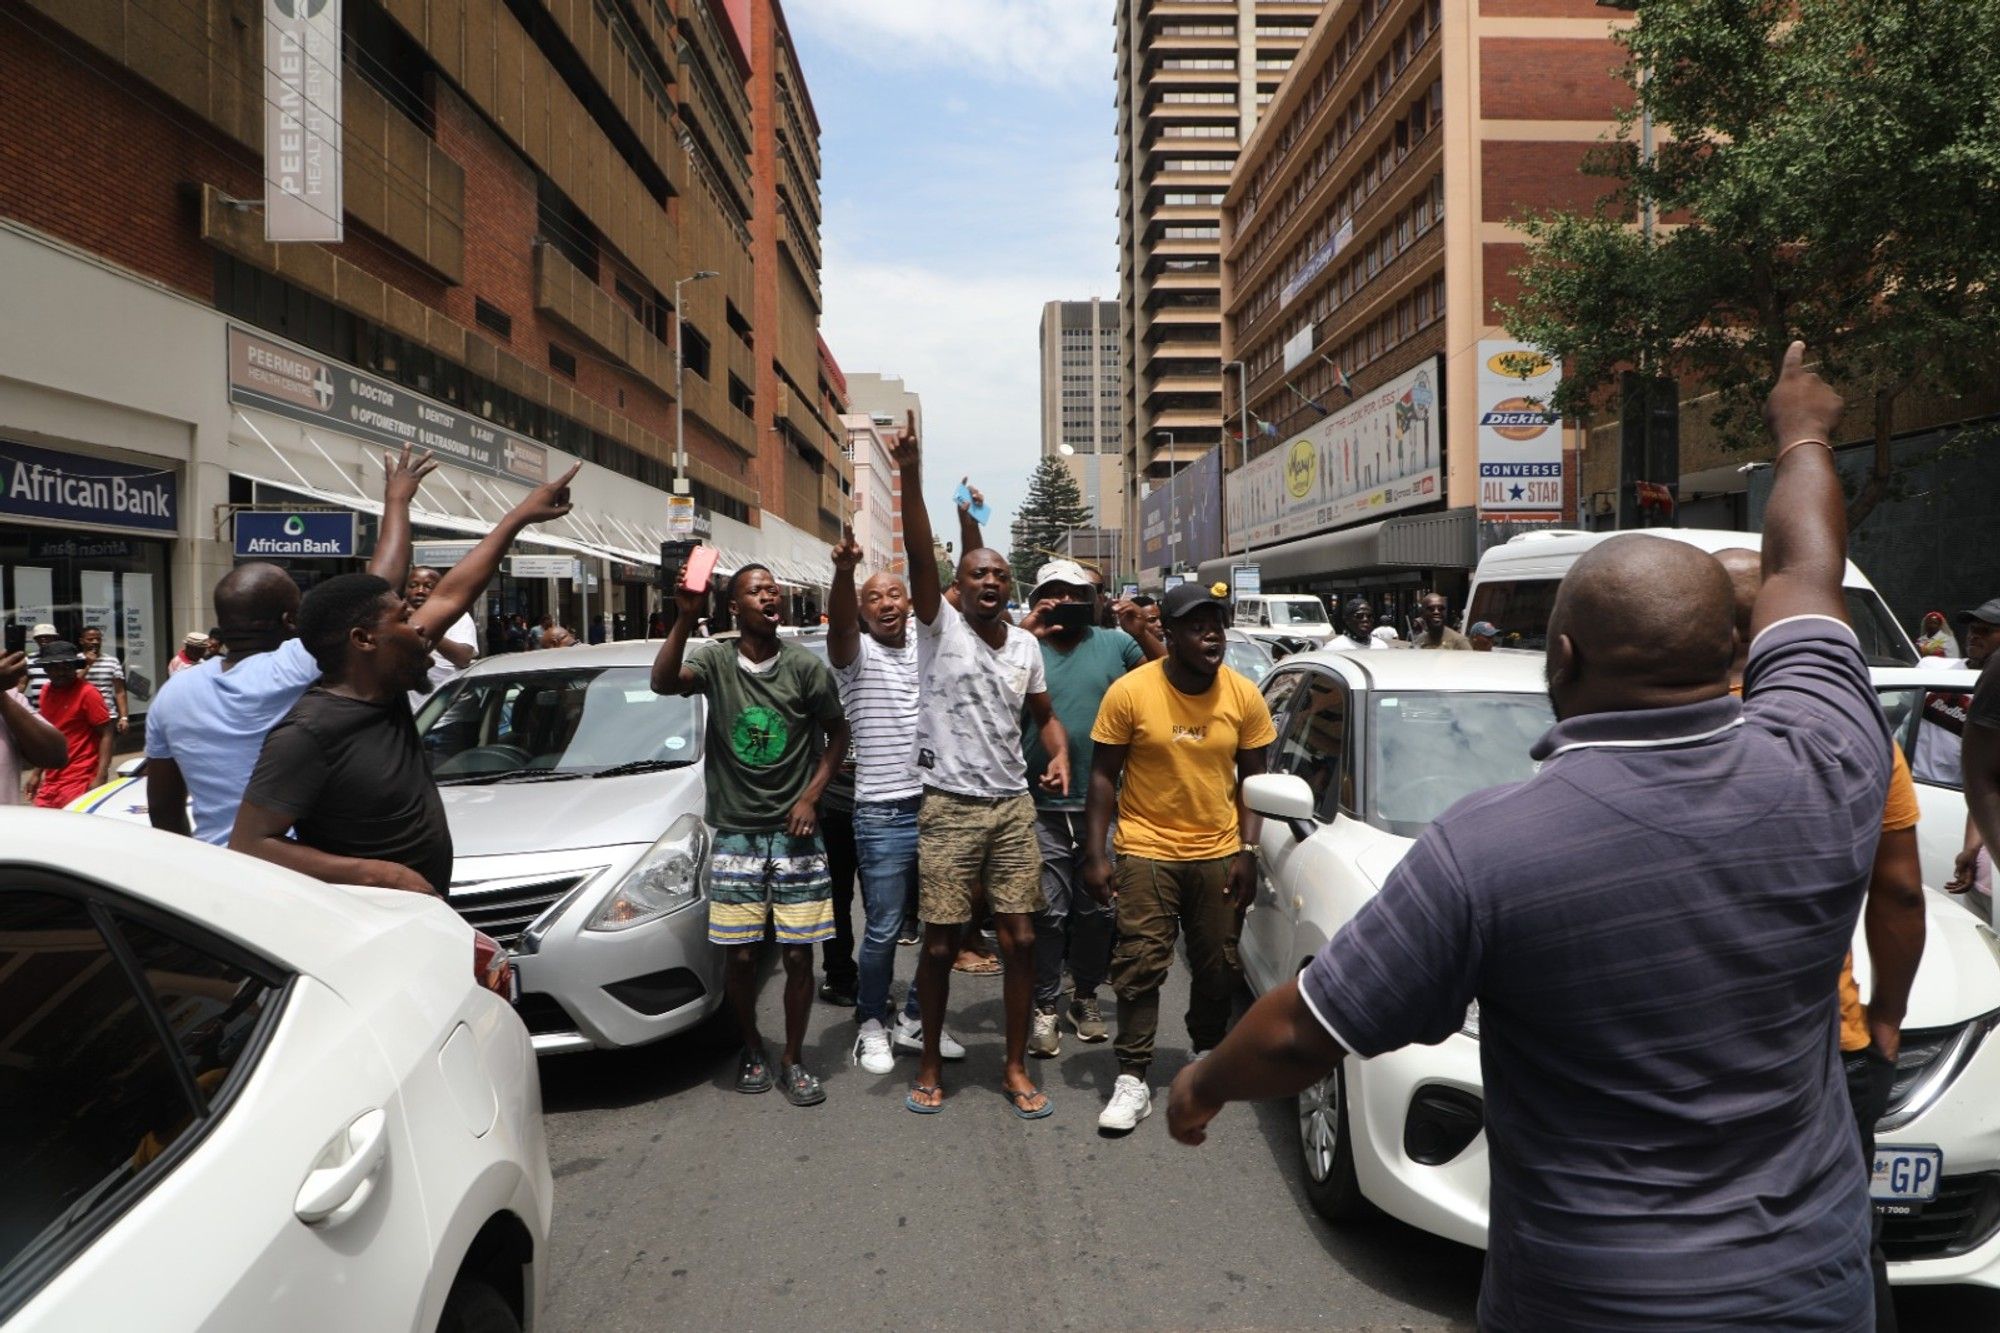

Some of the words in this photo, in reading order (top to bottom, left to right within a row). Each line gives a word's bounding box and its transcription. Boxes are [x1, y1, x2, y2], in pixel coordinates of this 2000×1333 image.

[280, 30, 301, 196] PEERMED
[306, 117, 322, 195] HEALTH
[247, 345, 311, 381] PEERMED
[247, 366, 281, 386] HEALTH
[359, 382, 394, 408] DOCTOR
[360, 408, 417, 438] OPTOMETRIST
[425, 407, 456, 430] DENTIST
[1487, 413, 1550, 424] Dickie
[425, 432, 470, 457] ULTRASOUND
[476, 427, 495, 444] X-RAY
[477, 448, 489, 463] LAB
[1482, 464, 1560, 476] CONVERSE
[9, 460, 109, 510] African
[112, 477, 171, 518] Bank
[1483, 481, 1506, 503] ALL
[1528, 481, 1559, 503] STAR
[247, 537, 301, 553] African
[303, 539, 341, 553] Bank
[1891, 1157, 1931, 1193] GP
[1888, 1206, 1910, 1214] 7000
